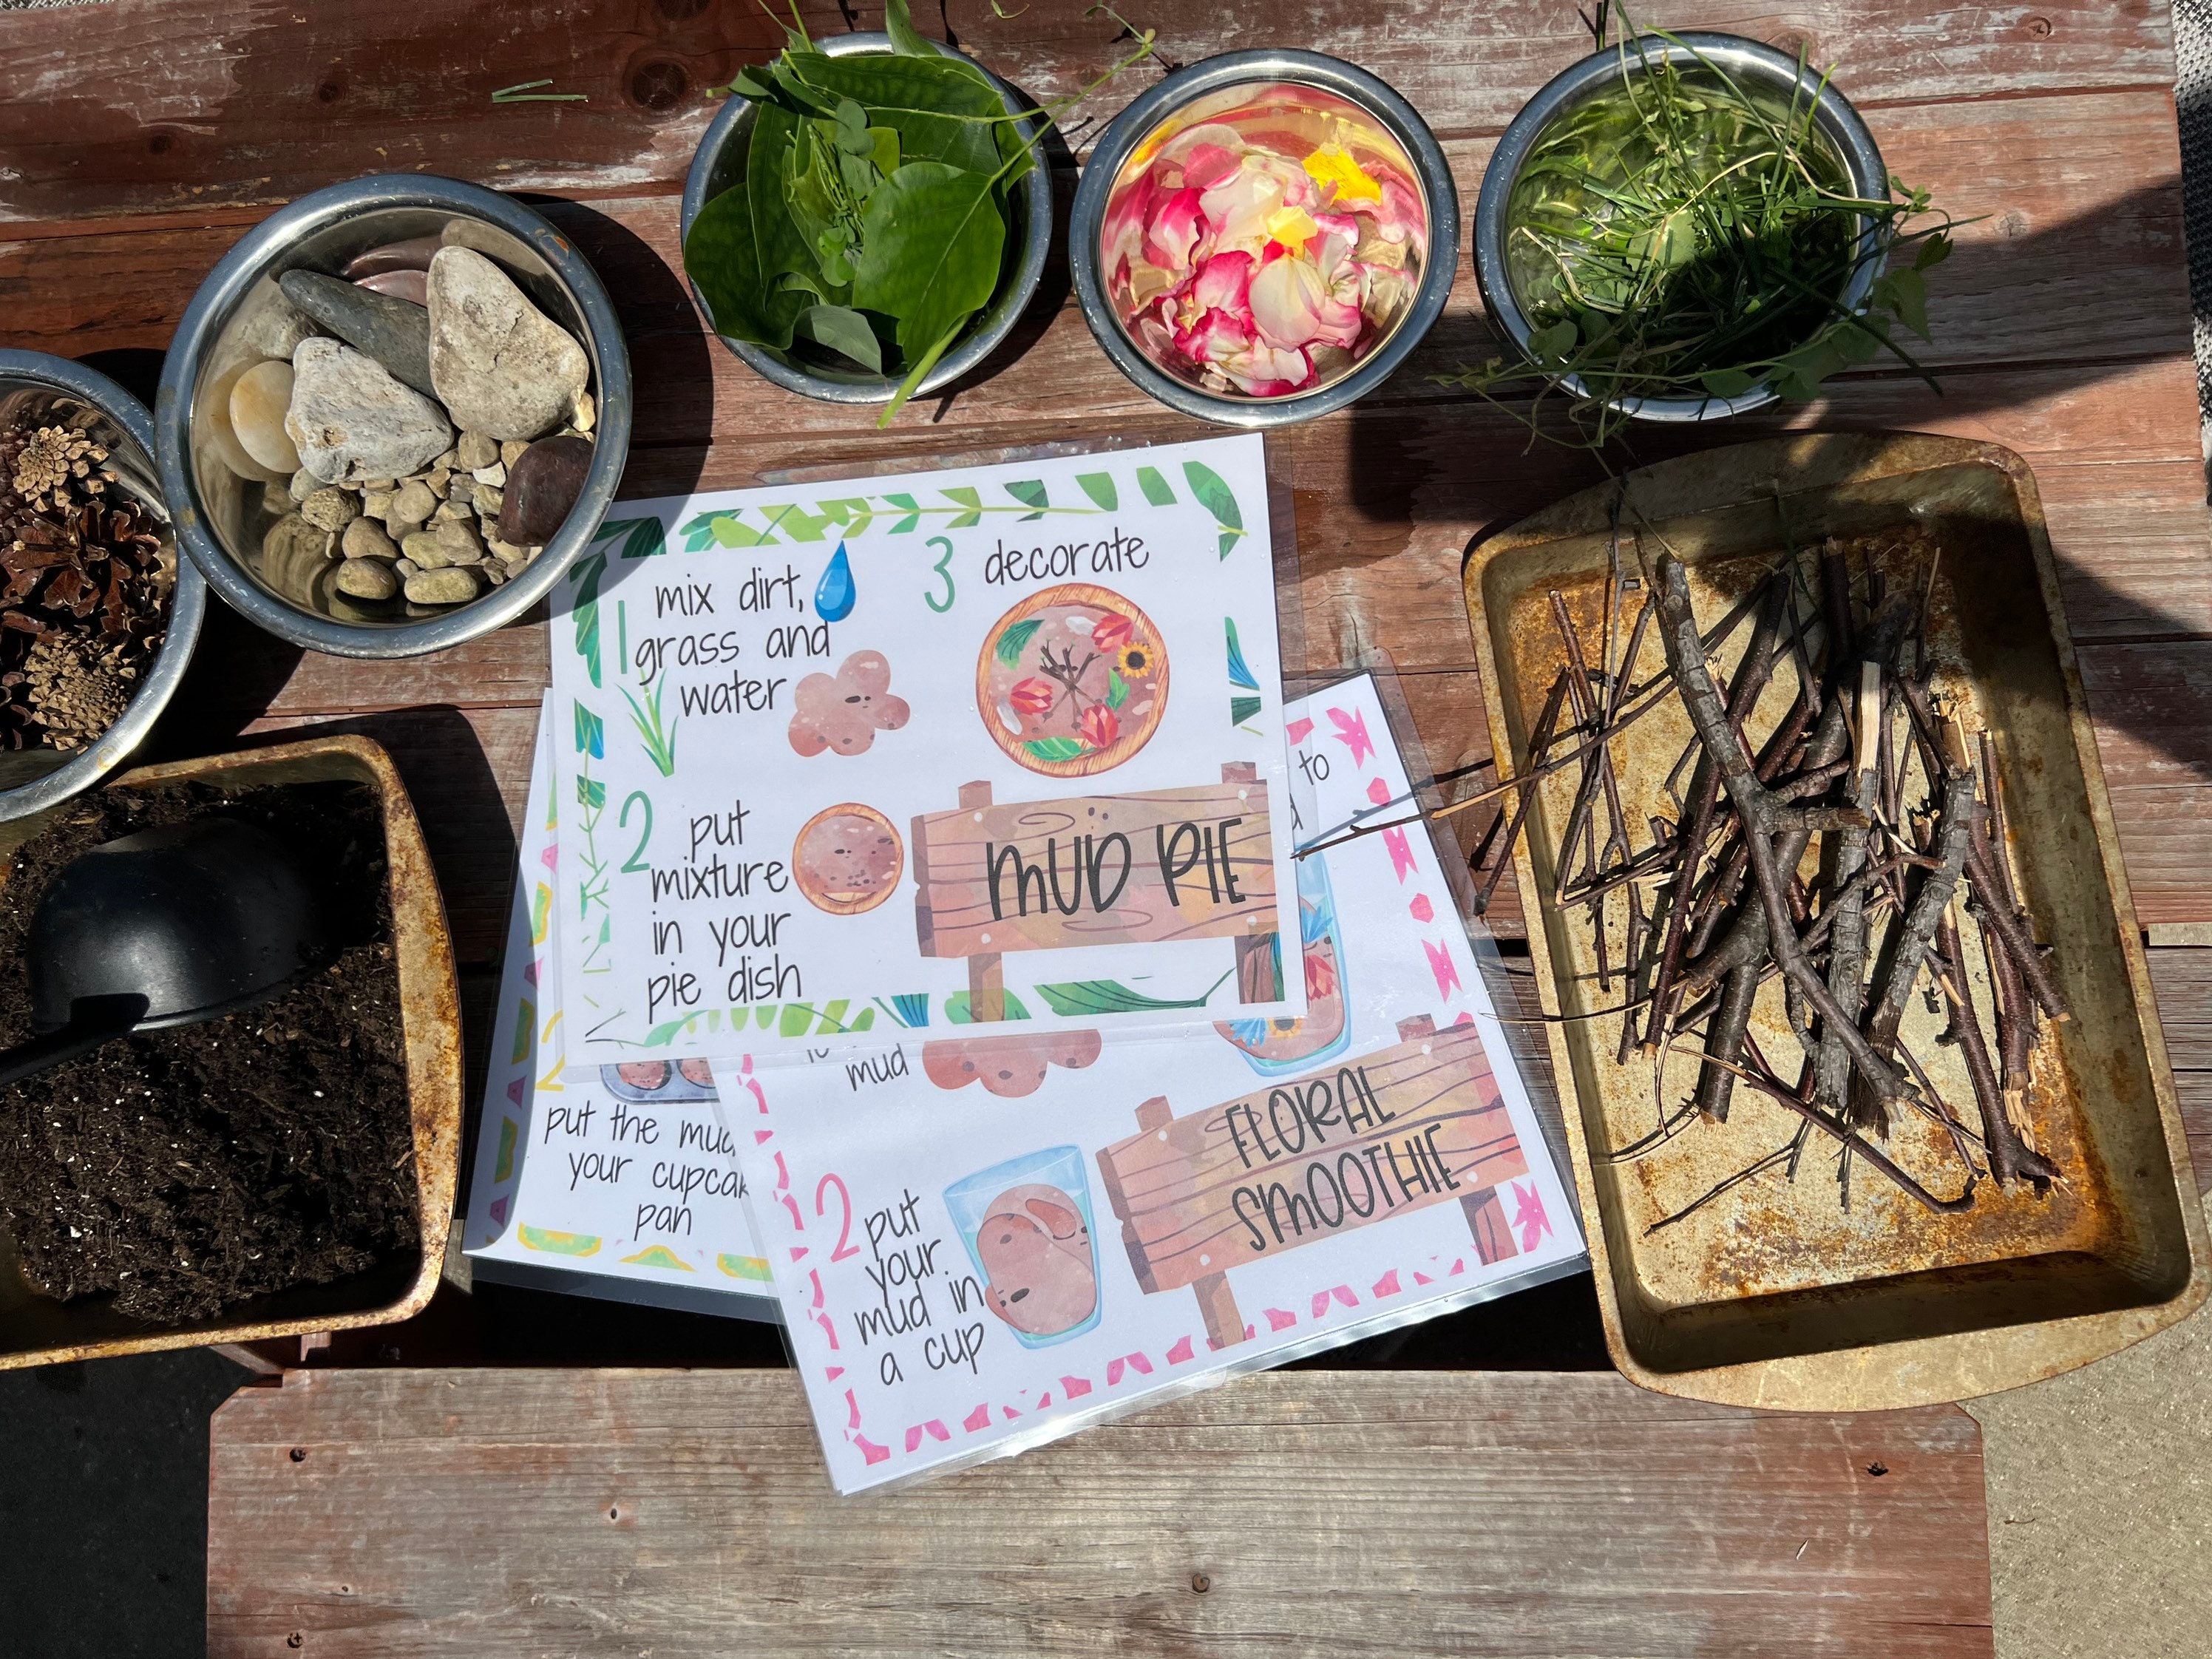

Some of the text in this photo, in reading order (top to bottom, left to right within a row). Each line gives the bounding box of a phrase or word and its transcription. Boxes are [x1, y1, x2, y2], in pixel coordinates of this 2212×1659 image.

[924, 536, 955, 613] 3
[985, 526, 1149, 586] decorate
[655, 564, 804, 619] mix dirt,
[635, 620, 830, 686] grass and
[680, 669, 787, 717] water
[1298, 750, 1330, 786] to
[620, 791, 750, 873] 2 put
[651, 852, 788, 903] mixture
[986, 817, 1246, 922] MUD PIE
[653, 910, 791, 967] in your
[648, 953, 801, 1025] pie dish
[845, 1042, 909, 1092] mud
[544, 1100, 597, 1144] put
[610, 1104, 659, 1144] the
[1224, 1065, 1397, 1169] FLORAL
[569, 1153, 633, 1191] your
[1232, 1122, 1461, 1252] SMOOTHIE
[634, 1204, 691, 1241] pan
[815, 1173, 920, 1263] 2 put
[865, 1239, 941, 1309] your
[854, 1270, 985, 1346] mud in
[880, 1323, 985, 1386] a cup
